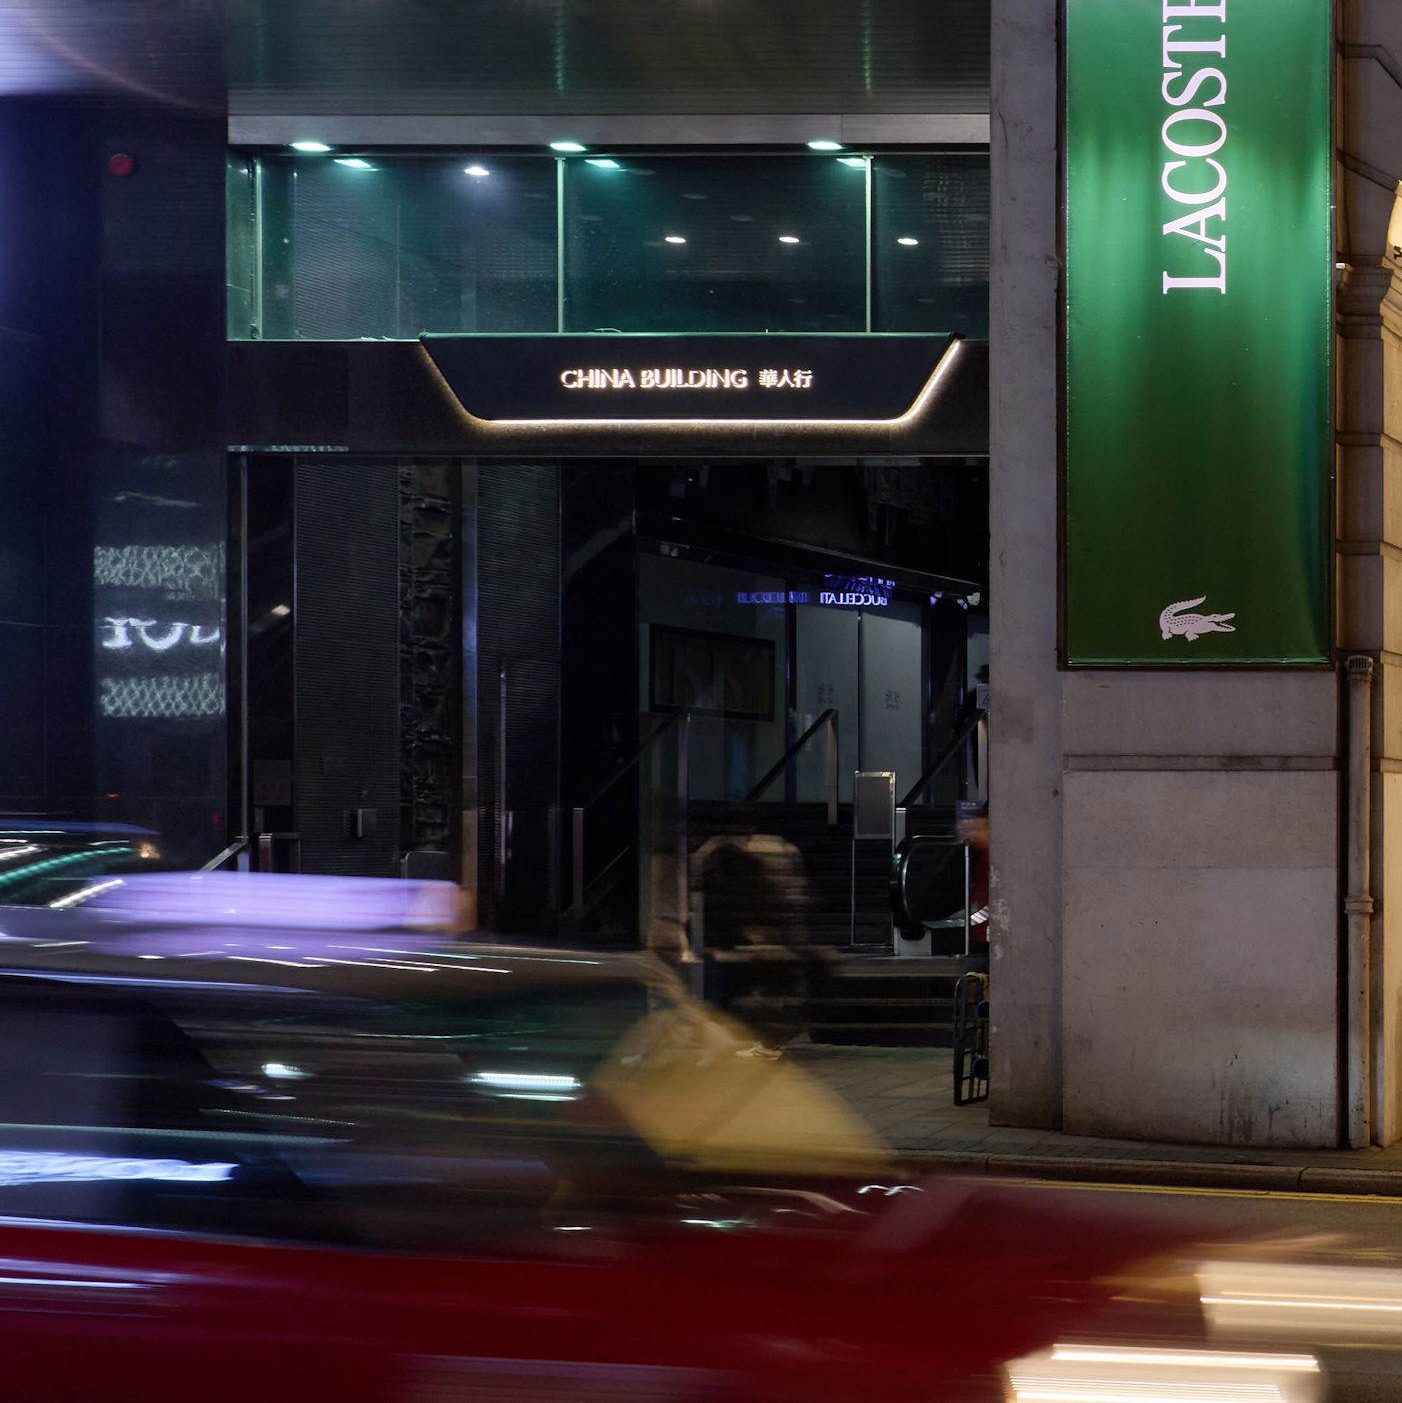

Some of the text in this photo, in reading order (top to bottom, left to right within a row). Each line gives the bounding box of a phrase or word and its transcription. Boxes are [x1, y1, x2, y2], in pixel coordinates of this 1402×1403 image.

[560, 368, 813, 389] CHINA BUILDING 華人行
